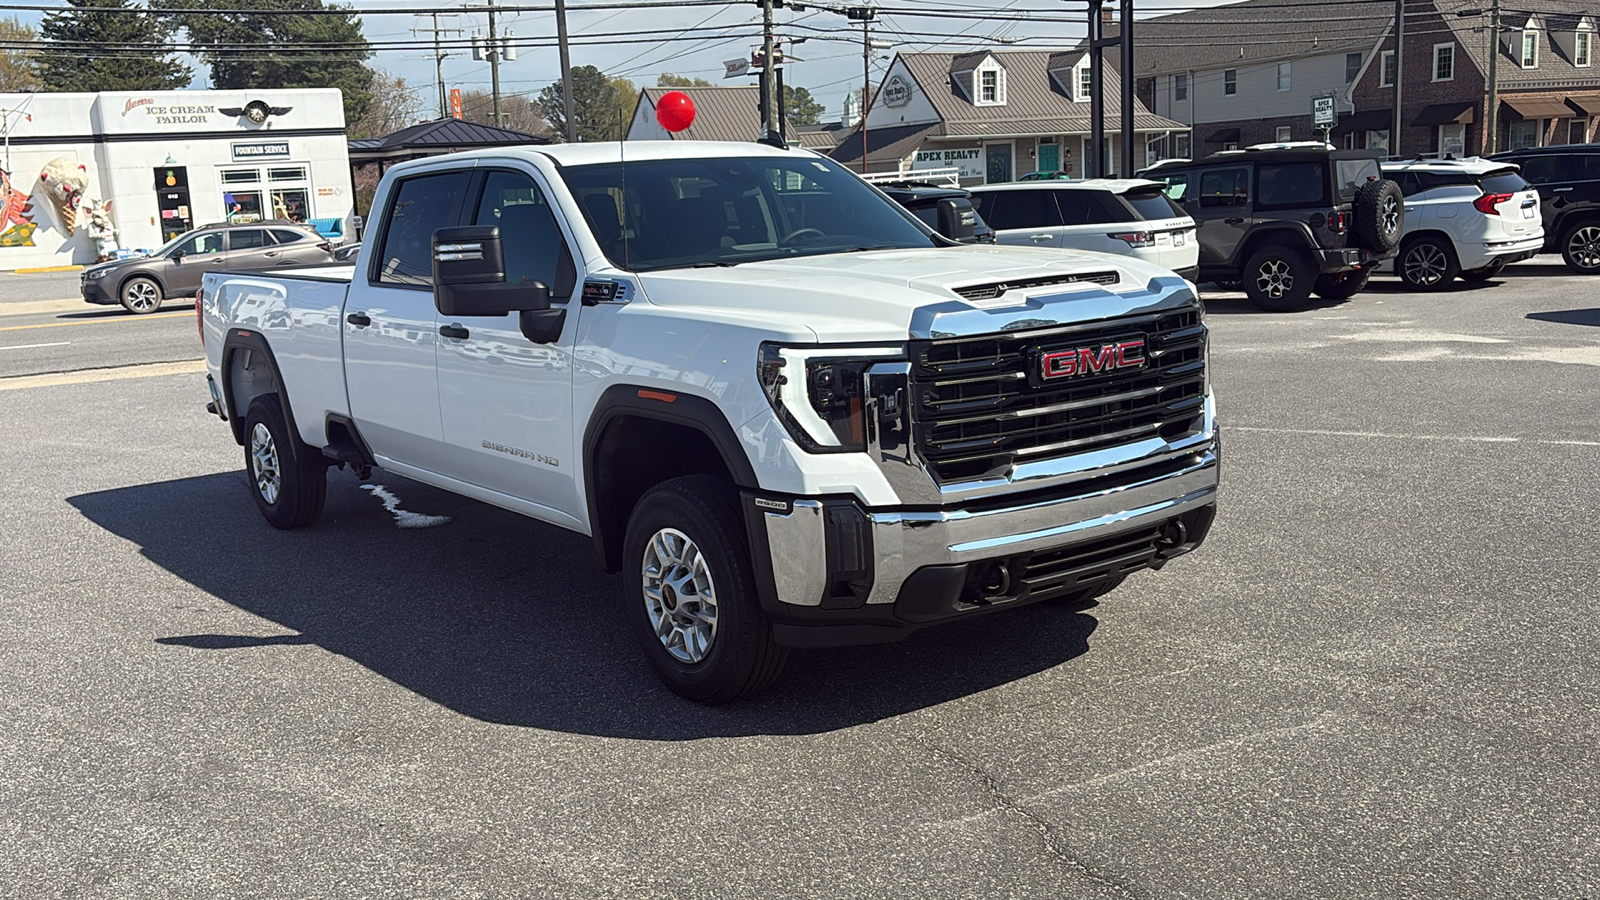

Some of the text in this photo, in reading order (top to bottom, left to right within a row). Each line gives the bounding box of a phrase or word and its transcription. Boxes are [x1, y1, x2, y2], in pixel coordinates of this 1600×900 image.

[146, 105, 215, 115] ICE CREAM
[156, 115, 208, 124] PARLOR
[235, 144, 288, 155] FOUNTAIN SERVICE
[917, 149, 980, 162] APEX REALTY
[1041, 339, 1145, 379] GMC
[481, 440, 559, 467] SIERRA HD
[756, 500, 786, 508] 2500
